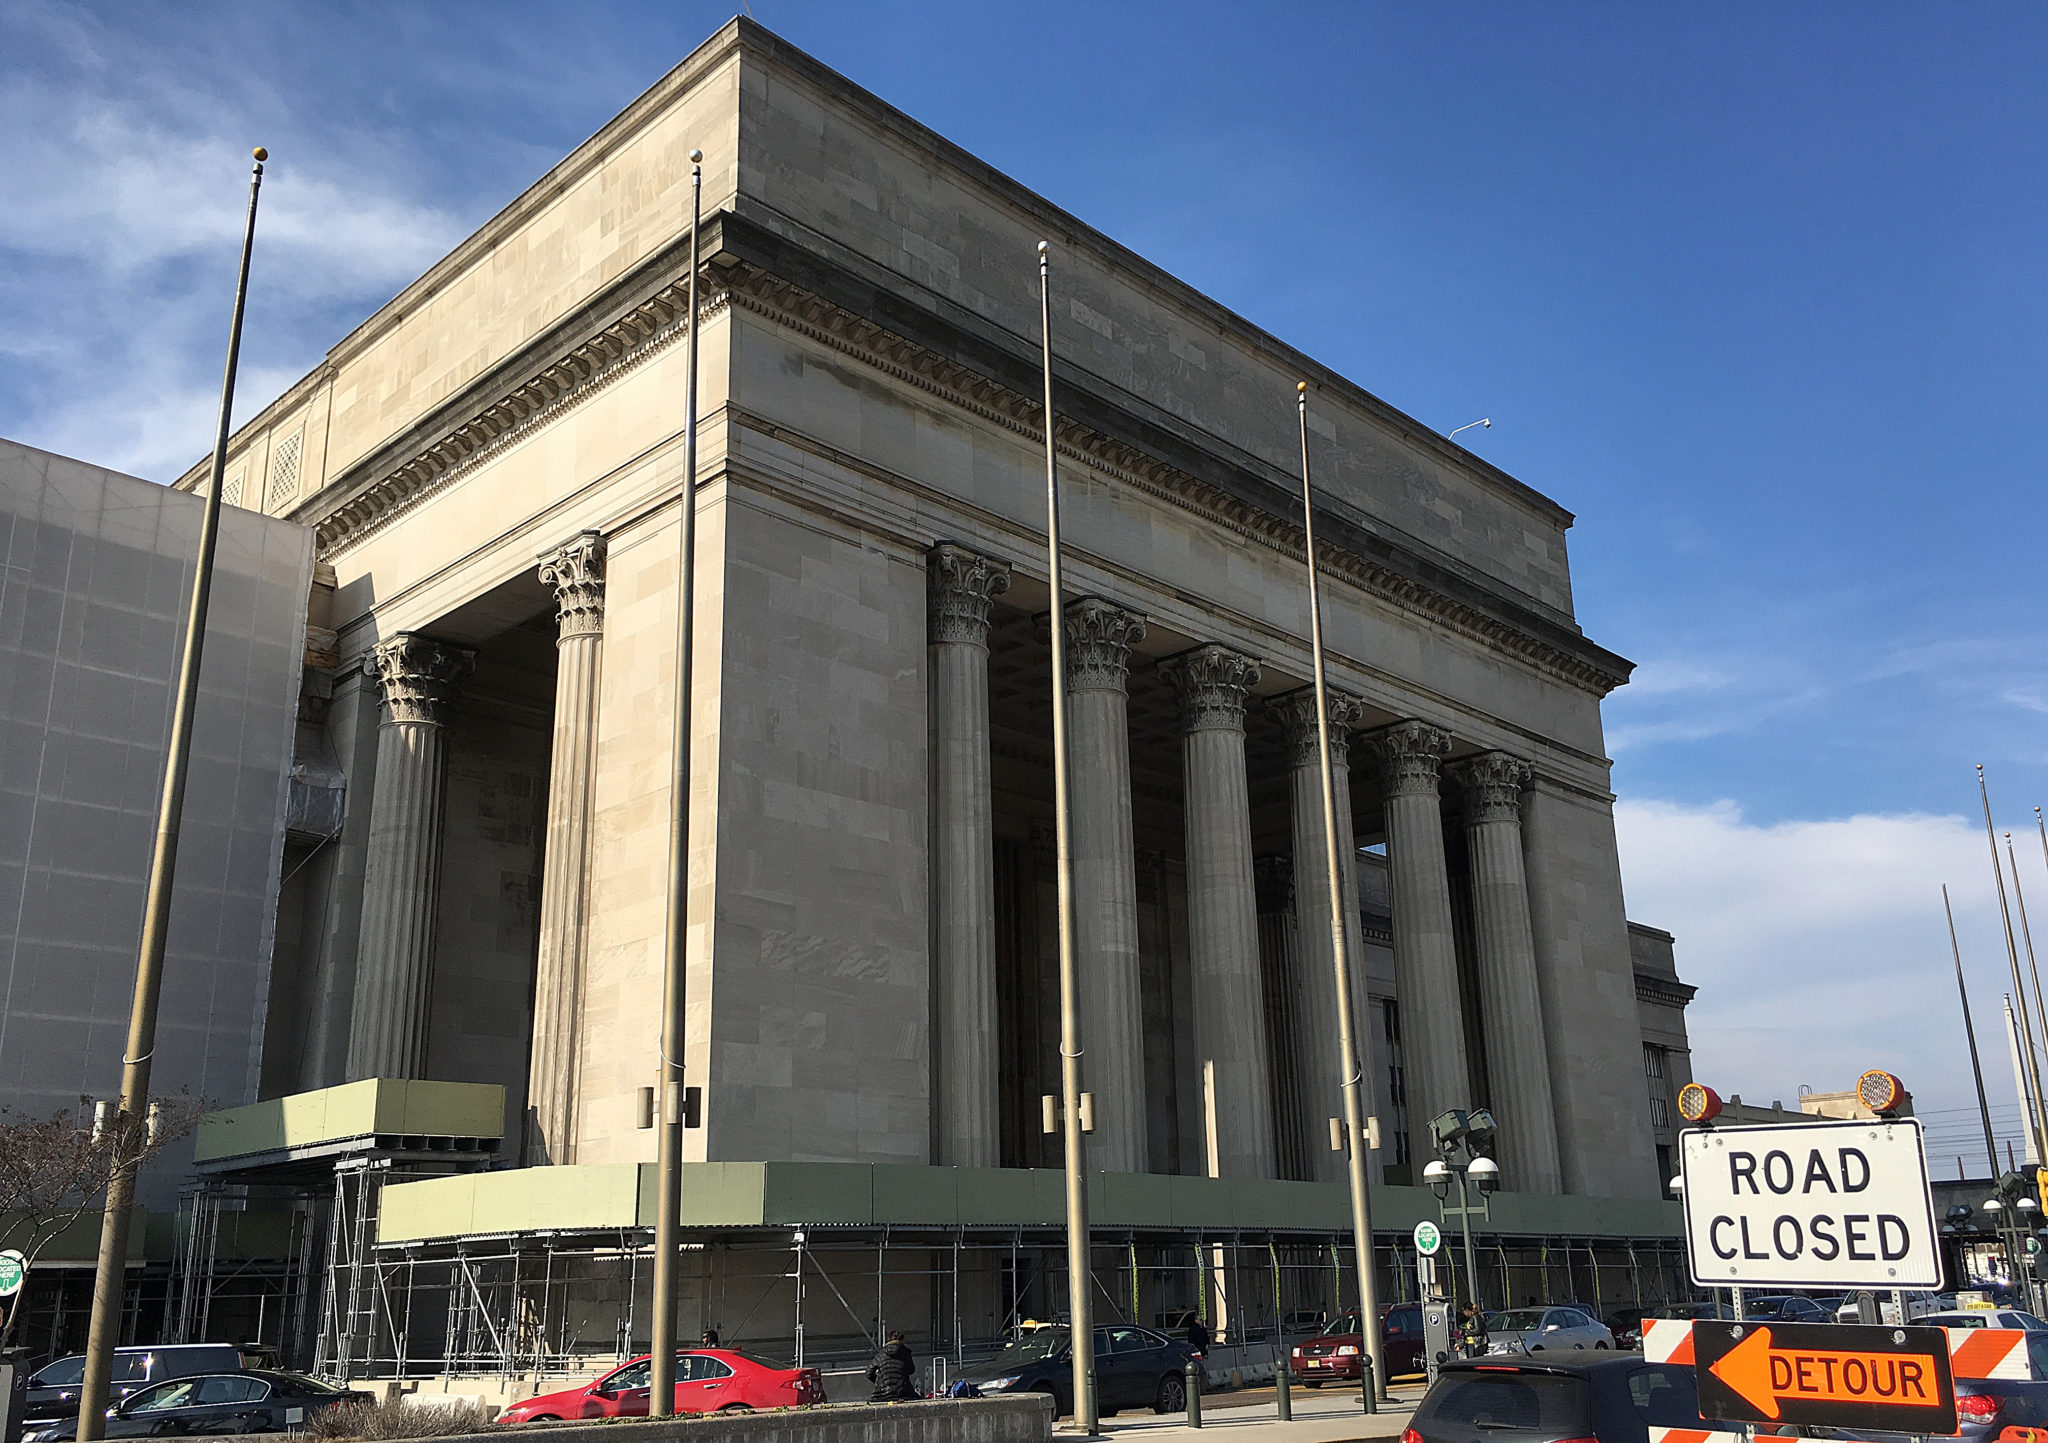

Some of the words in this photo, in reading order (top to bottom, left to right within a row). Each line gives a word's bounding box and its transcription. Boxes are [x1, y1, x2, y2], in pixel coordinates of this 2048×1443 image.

[1728, 1147, 1871, 1195] ROAD
[1709, 1214, 1910, 1261] CLOSED
[1769, 1355, 1926, 1398] DETOUR
